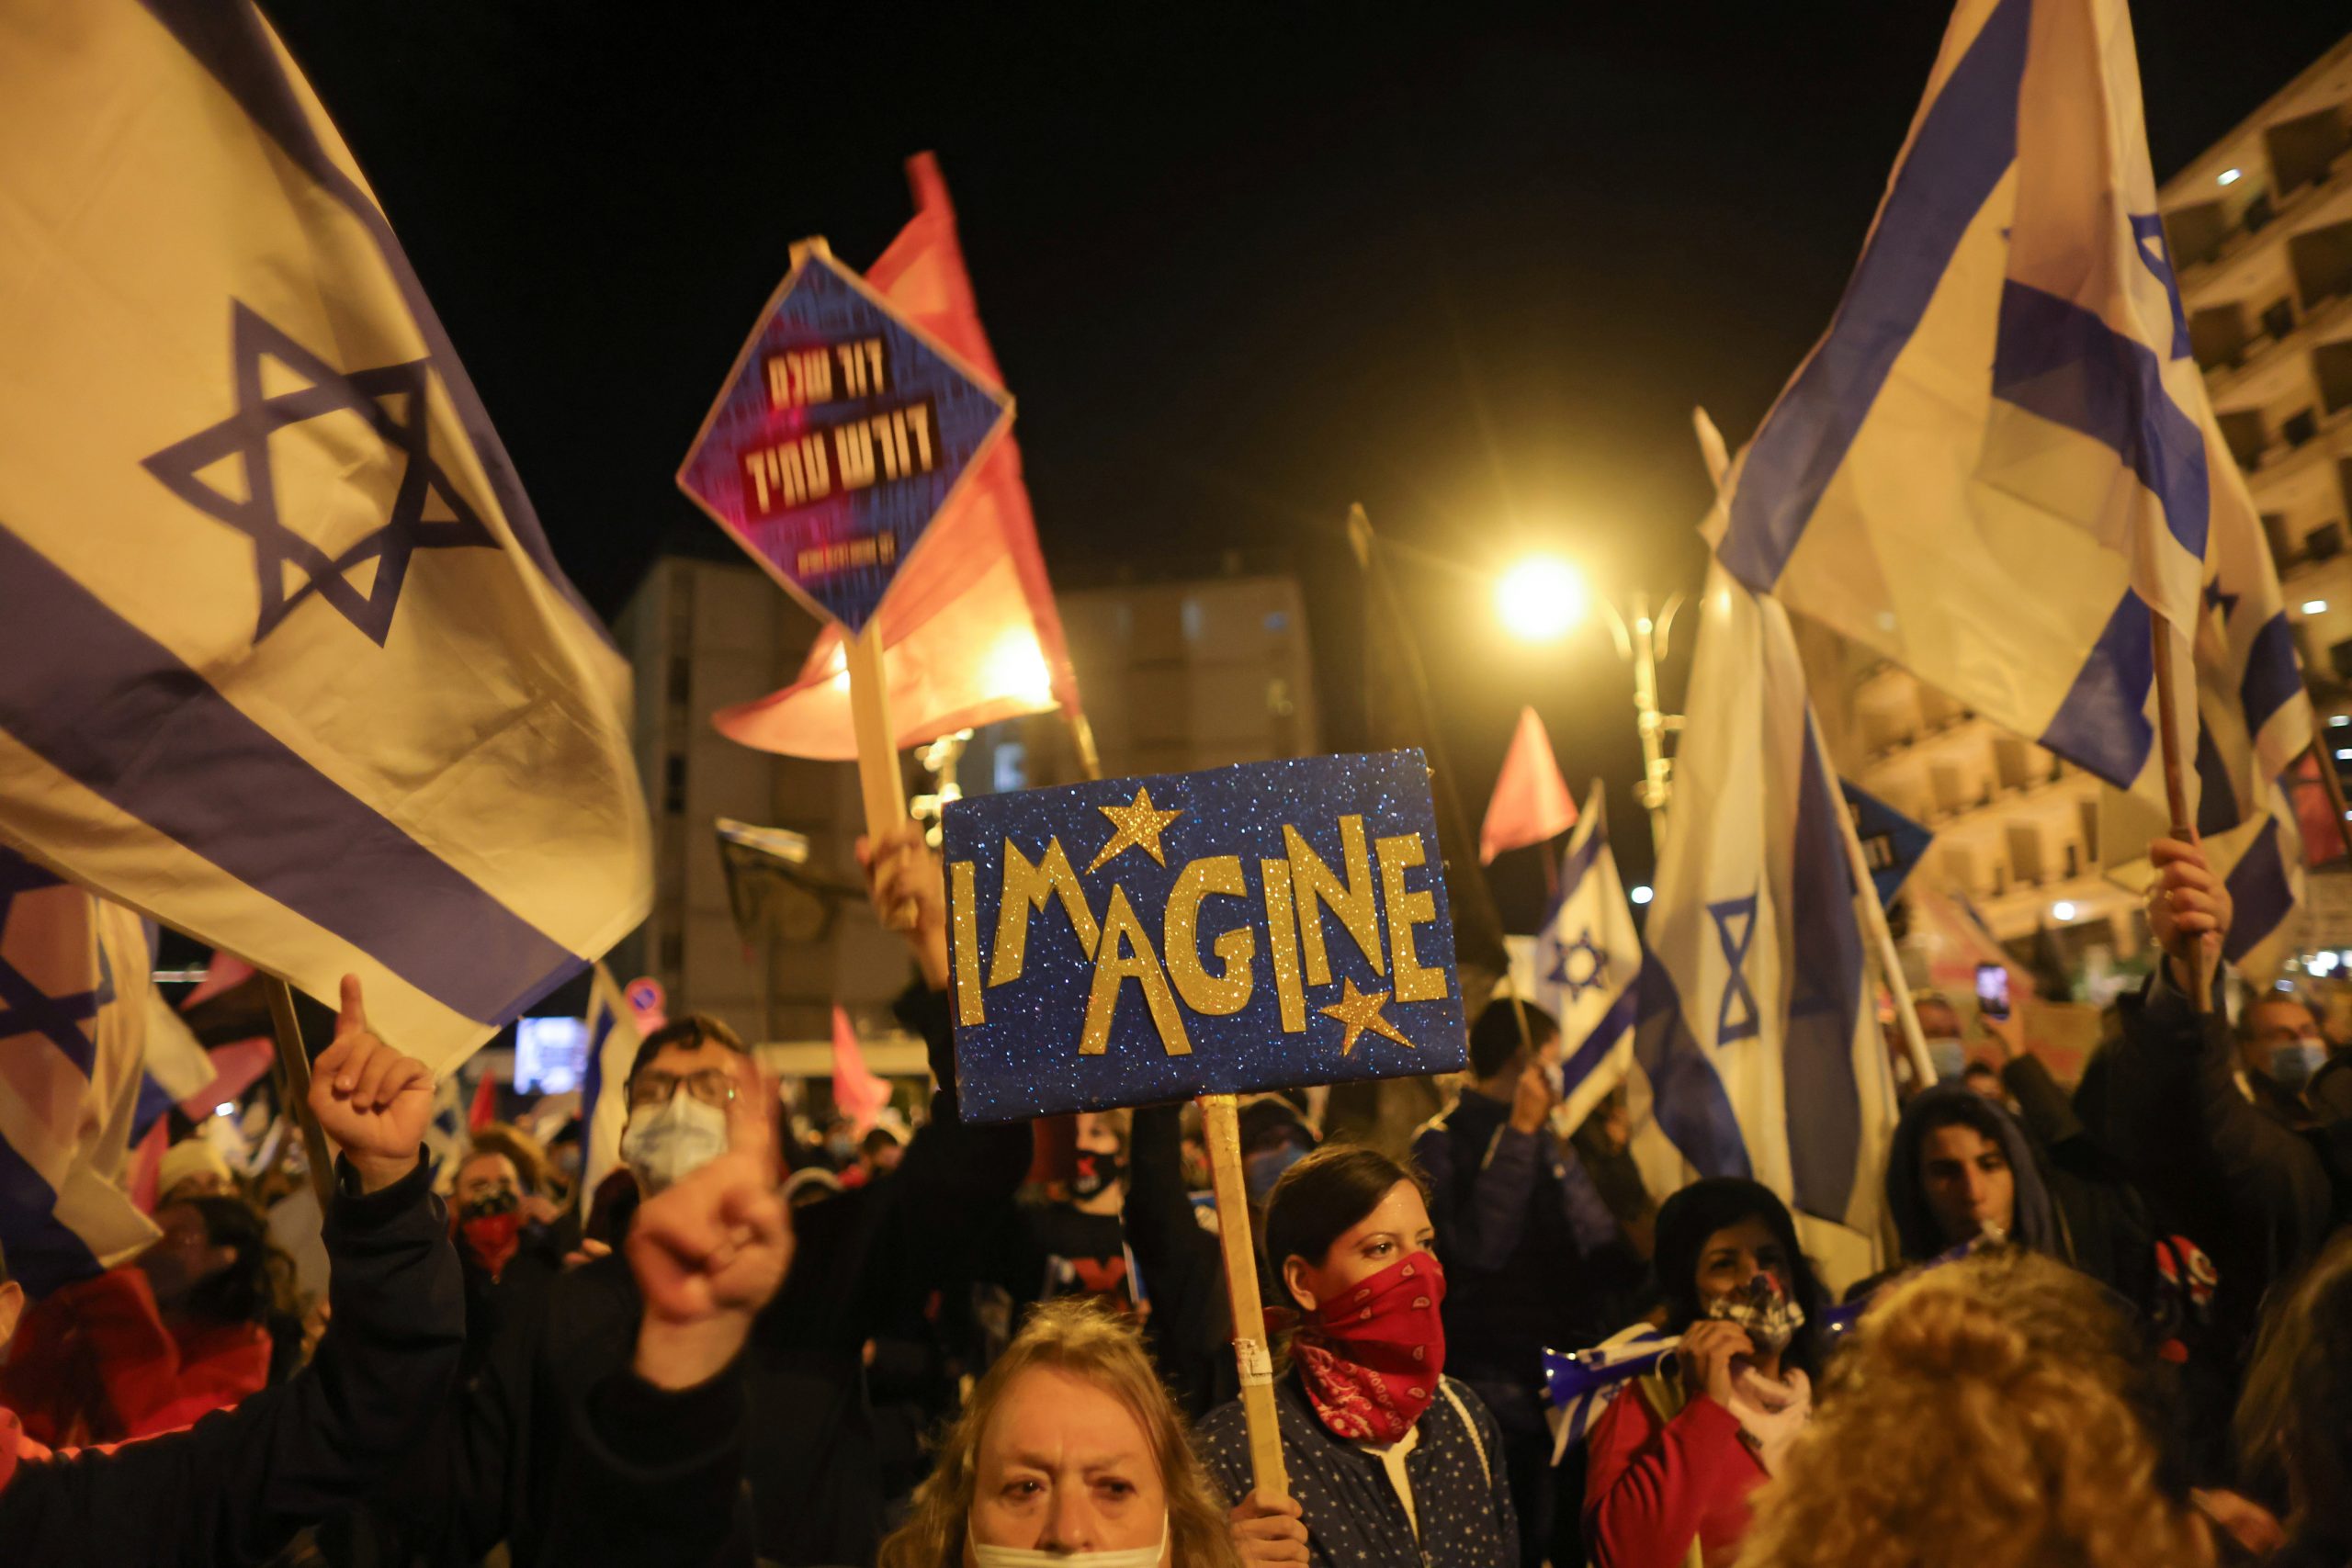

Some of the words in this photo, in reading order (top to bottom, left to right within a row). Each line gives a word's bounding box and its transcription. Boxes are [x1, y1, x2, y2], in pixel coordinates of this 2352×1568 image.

[836, 339, 883, 399] דור
[745, 432, 831, 514] עתיד
[834, 404, 933, 491] דורש
[950, 814, 1448, 1055] IMAGINE
